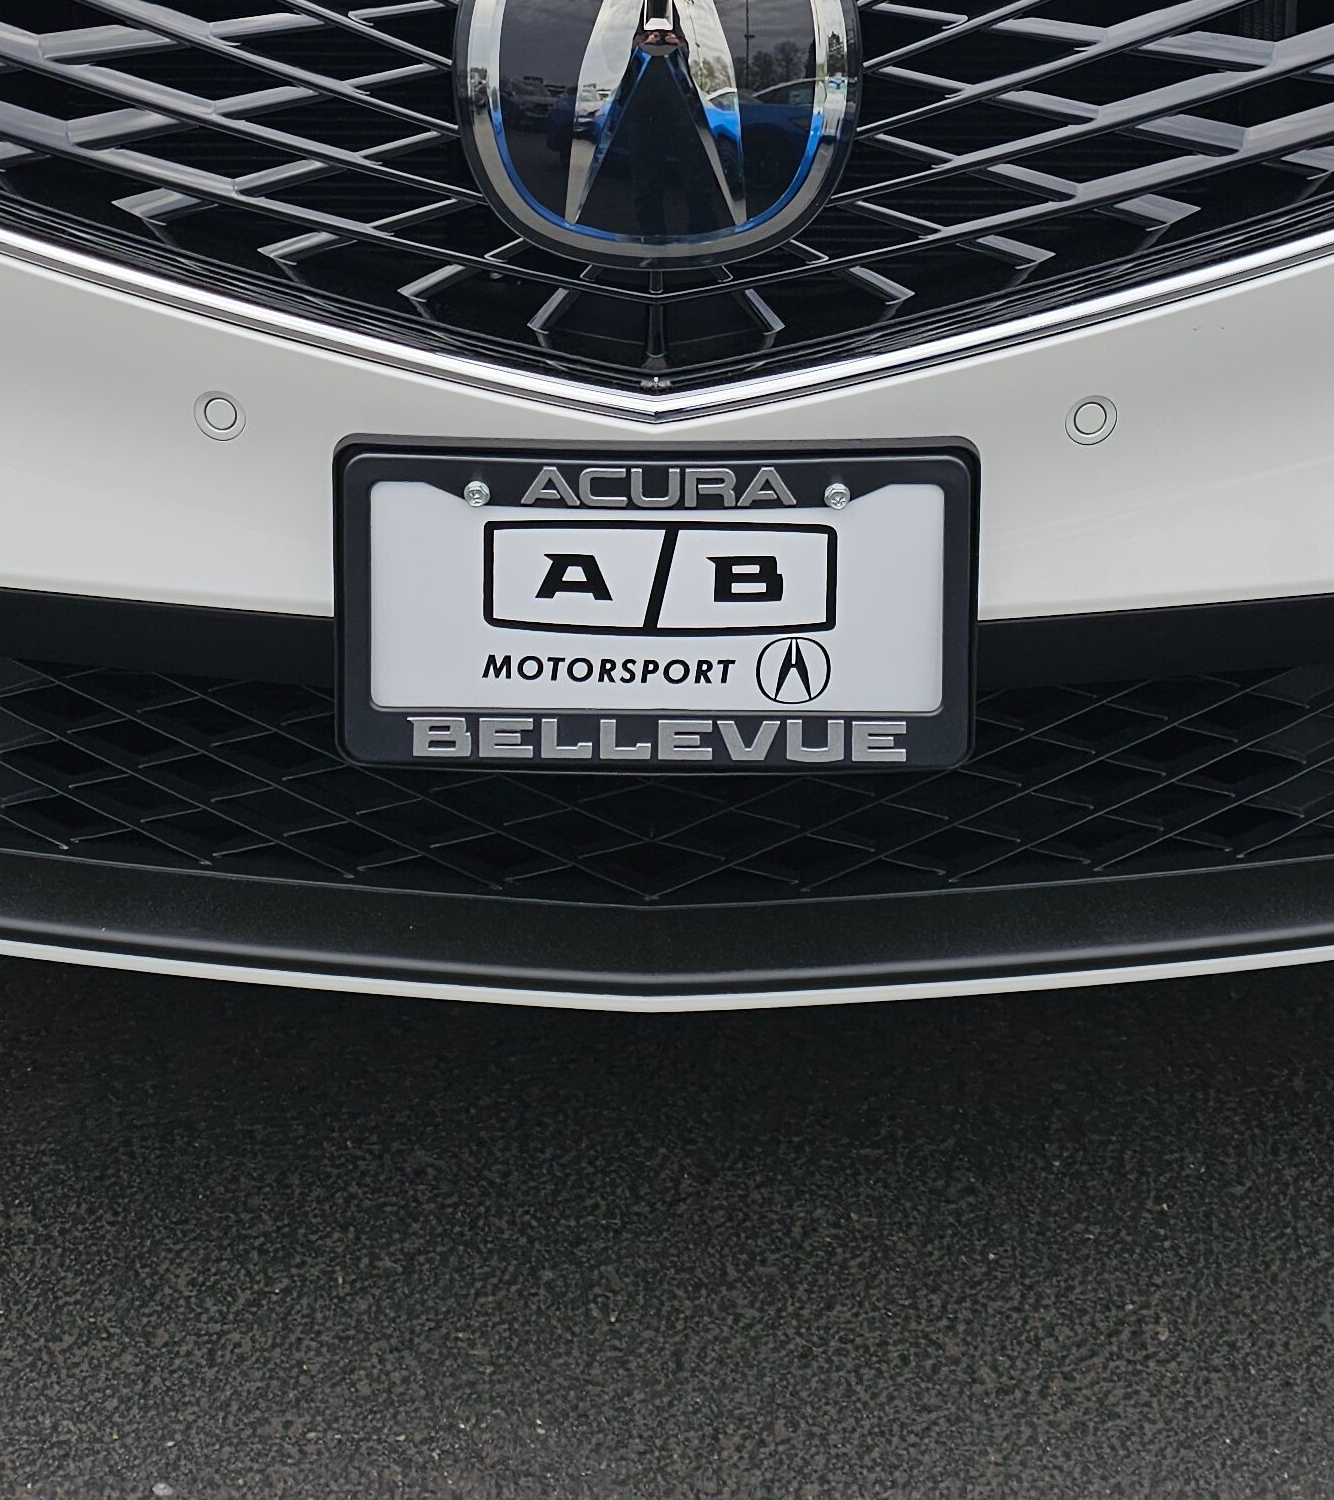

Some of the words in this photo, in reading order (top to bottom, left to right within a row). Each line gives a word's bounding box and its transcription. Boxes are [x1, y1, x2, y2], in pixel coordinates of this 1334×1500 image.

[520, 466, 797, 508] ACURA
[535, 553, 613, 601] A
[706, 555, 784, 603] B
[481, 653, 736, 684] MOTORSPORT
[406, 716, 908, 763] BELLEVUE
